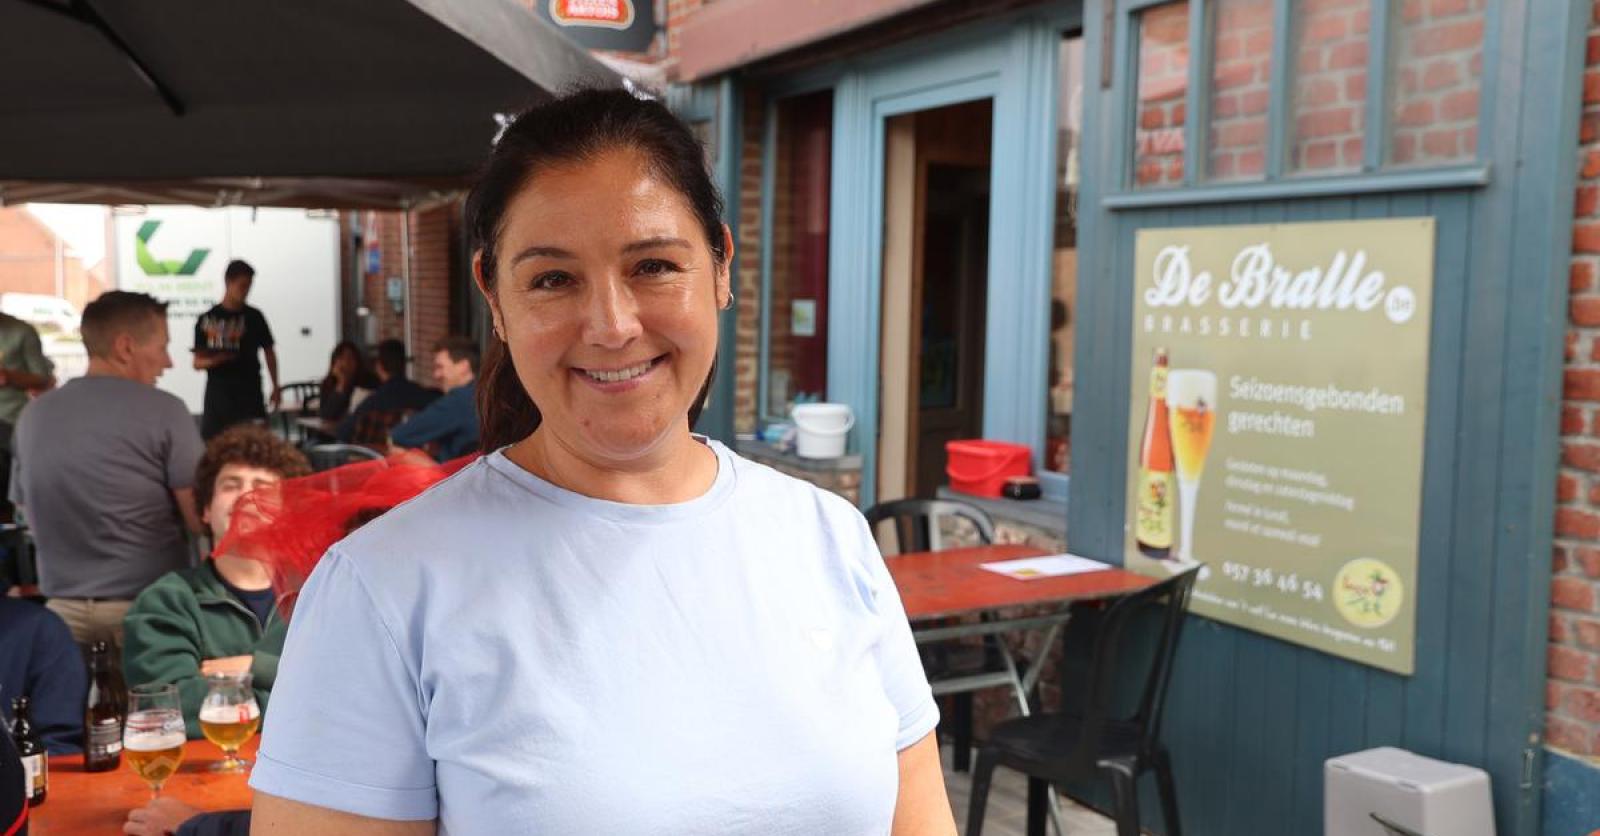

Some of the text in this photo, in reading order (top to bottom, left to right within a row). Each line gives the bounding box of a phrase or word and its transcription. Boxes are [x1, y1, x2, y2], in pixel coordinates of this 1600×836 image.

[1145, 245, 1212, 306] De
[1218, 243, 1385, 311] Bralle
[1144, 314, 1312, 340] BRASSERIE
[1229, 375, 1405, 414] Seizoensgebonden
[1227, 411, 1315, 438] gerechten
[1222, 560, 1249, 581] 057
[1252, 567, 1273, 587] 36
[1277, 573, 1298, 592] 46
